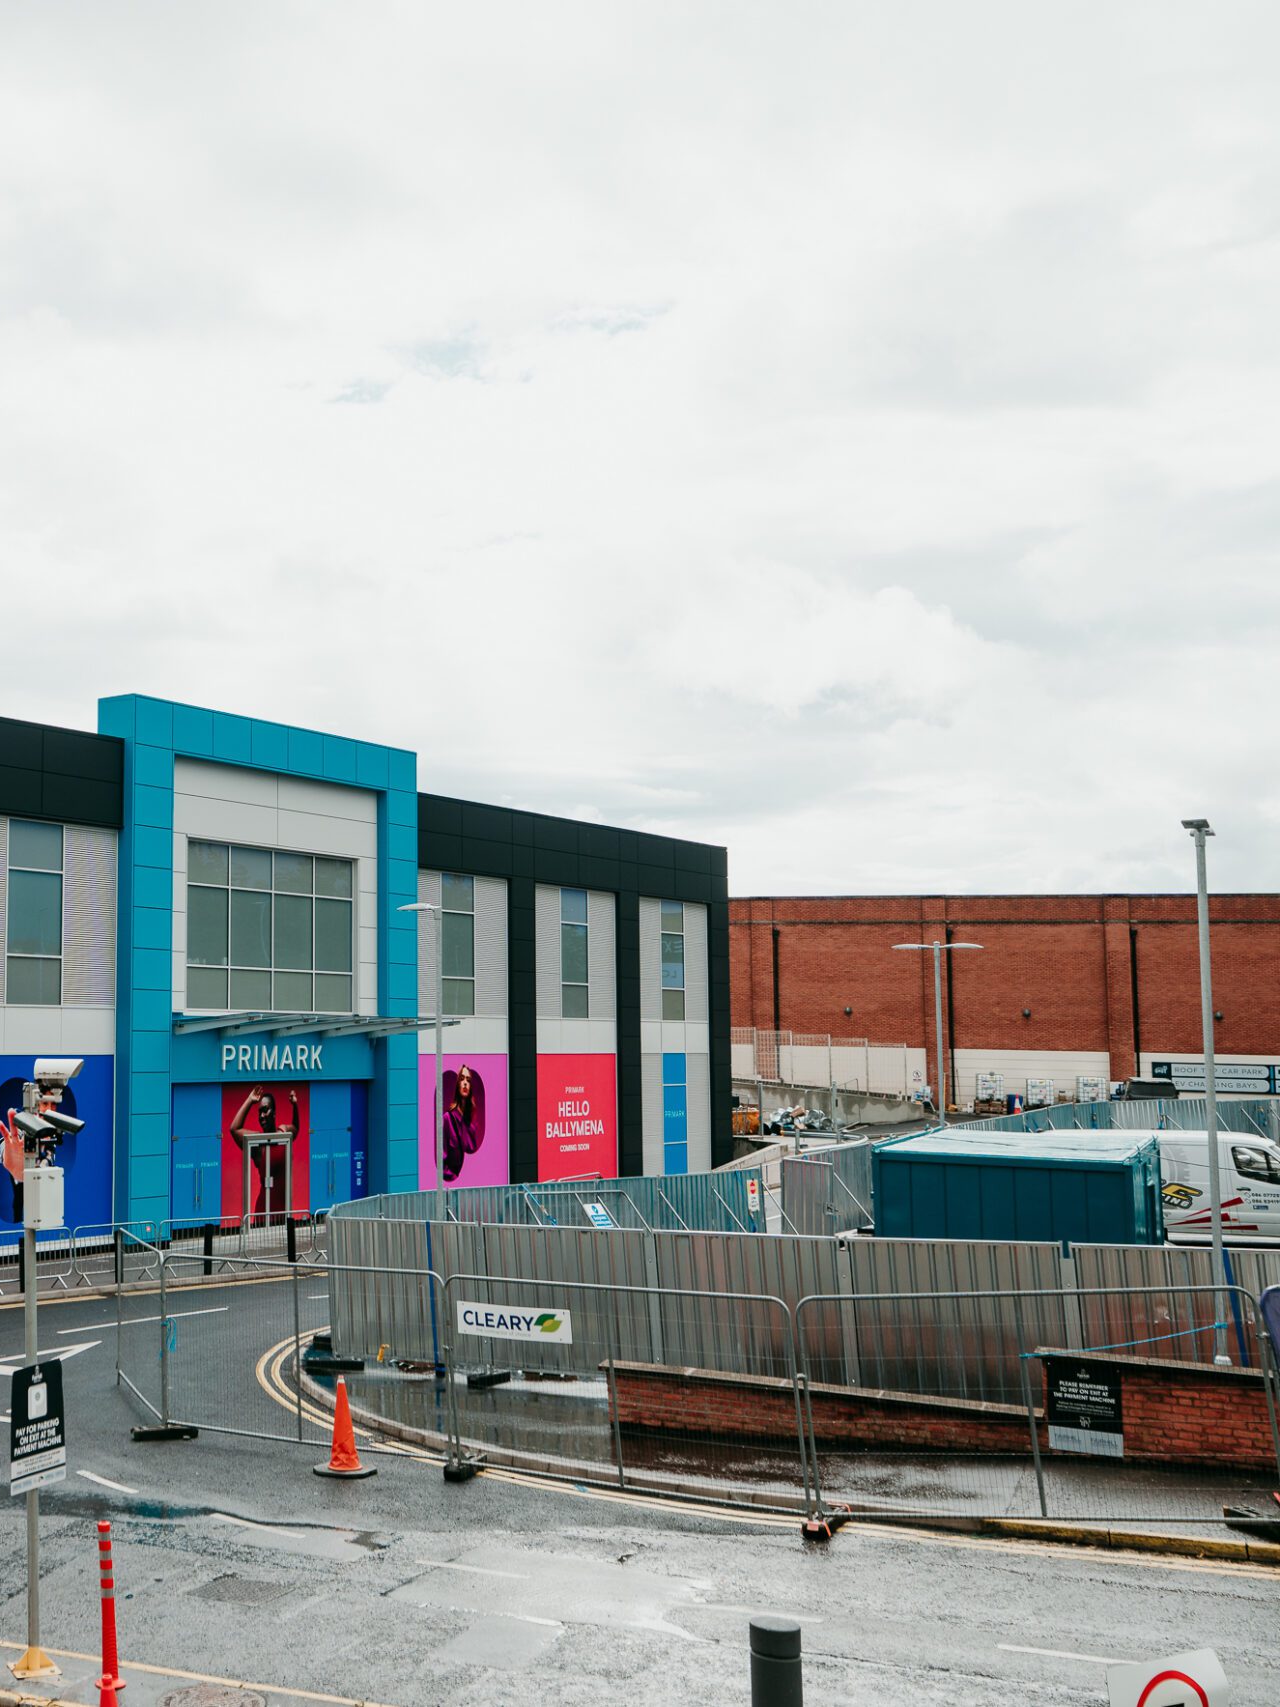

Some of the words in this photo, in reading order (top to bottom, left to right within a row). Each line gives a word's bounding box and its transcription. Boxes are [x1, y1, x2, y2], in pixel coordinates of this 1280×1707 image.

[221, 1044, 323, 1071] PRIMARK
[1174, 1066, 1198, 1074] ROOF
[1221, 1067, 1239, 1075] CAR
[1241, 1068, 1264, 1076] PARK
[565, 1086, 585, 1094] PRIMARK
[1188, 1081, 1234, 1089] CHAING
[1236, 1082, 1258, 1090] BAYS
[558, 1100, 590, 1118] HELLO
[664, 1110, 685, 1118] PRIMARK
[545, 1119, 605, 1139] BALLYMENA
[559, 1144, 577, 1153] COMING
[577, 1143, 590, 1152] SOON
[463, 1310, 535, 1332] CLEARY
[1059, 1380, 1078, 1388] PLEASE
[1078, 1382, 1109, 1391] REMEMBER
[1064, 1393, 1089, 1401] PAYMENT
[1089, 1395, 1116, 1405] MACHINE
[15, 1427, 26, 1438] PAY
[26, 1424, 37, 1435] FOR
[37, 1417, 60, 1430] PARKING
[20, 1435, 29, 1446] ON
[29, 1432, 40, 1443] EXIT
[40, 1430, 47, 1440] AT
[47, 1427, 56, 1437] THE
[14, 1441, 38, 1457] PAYMENT
[38, 1434, 62, 1450] MACHINE
